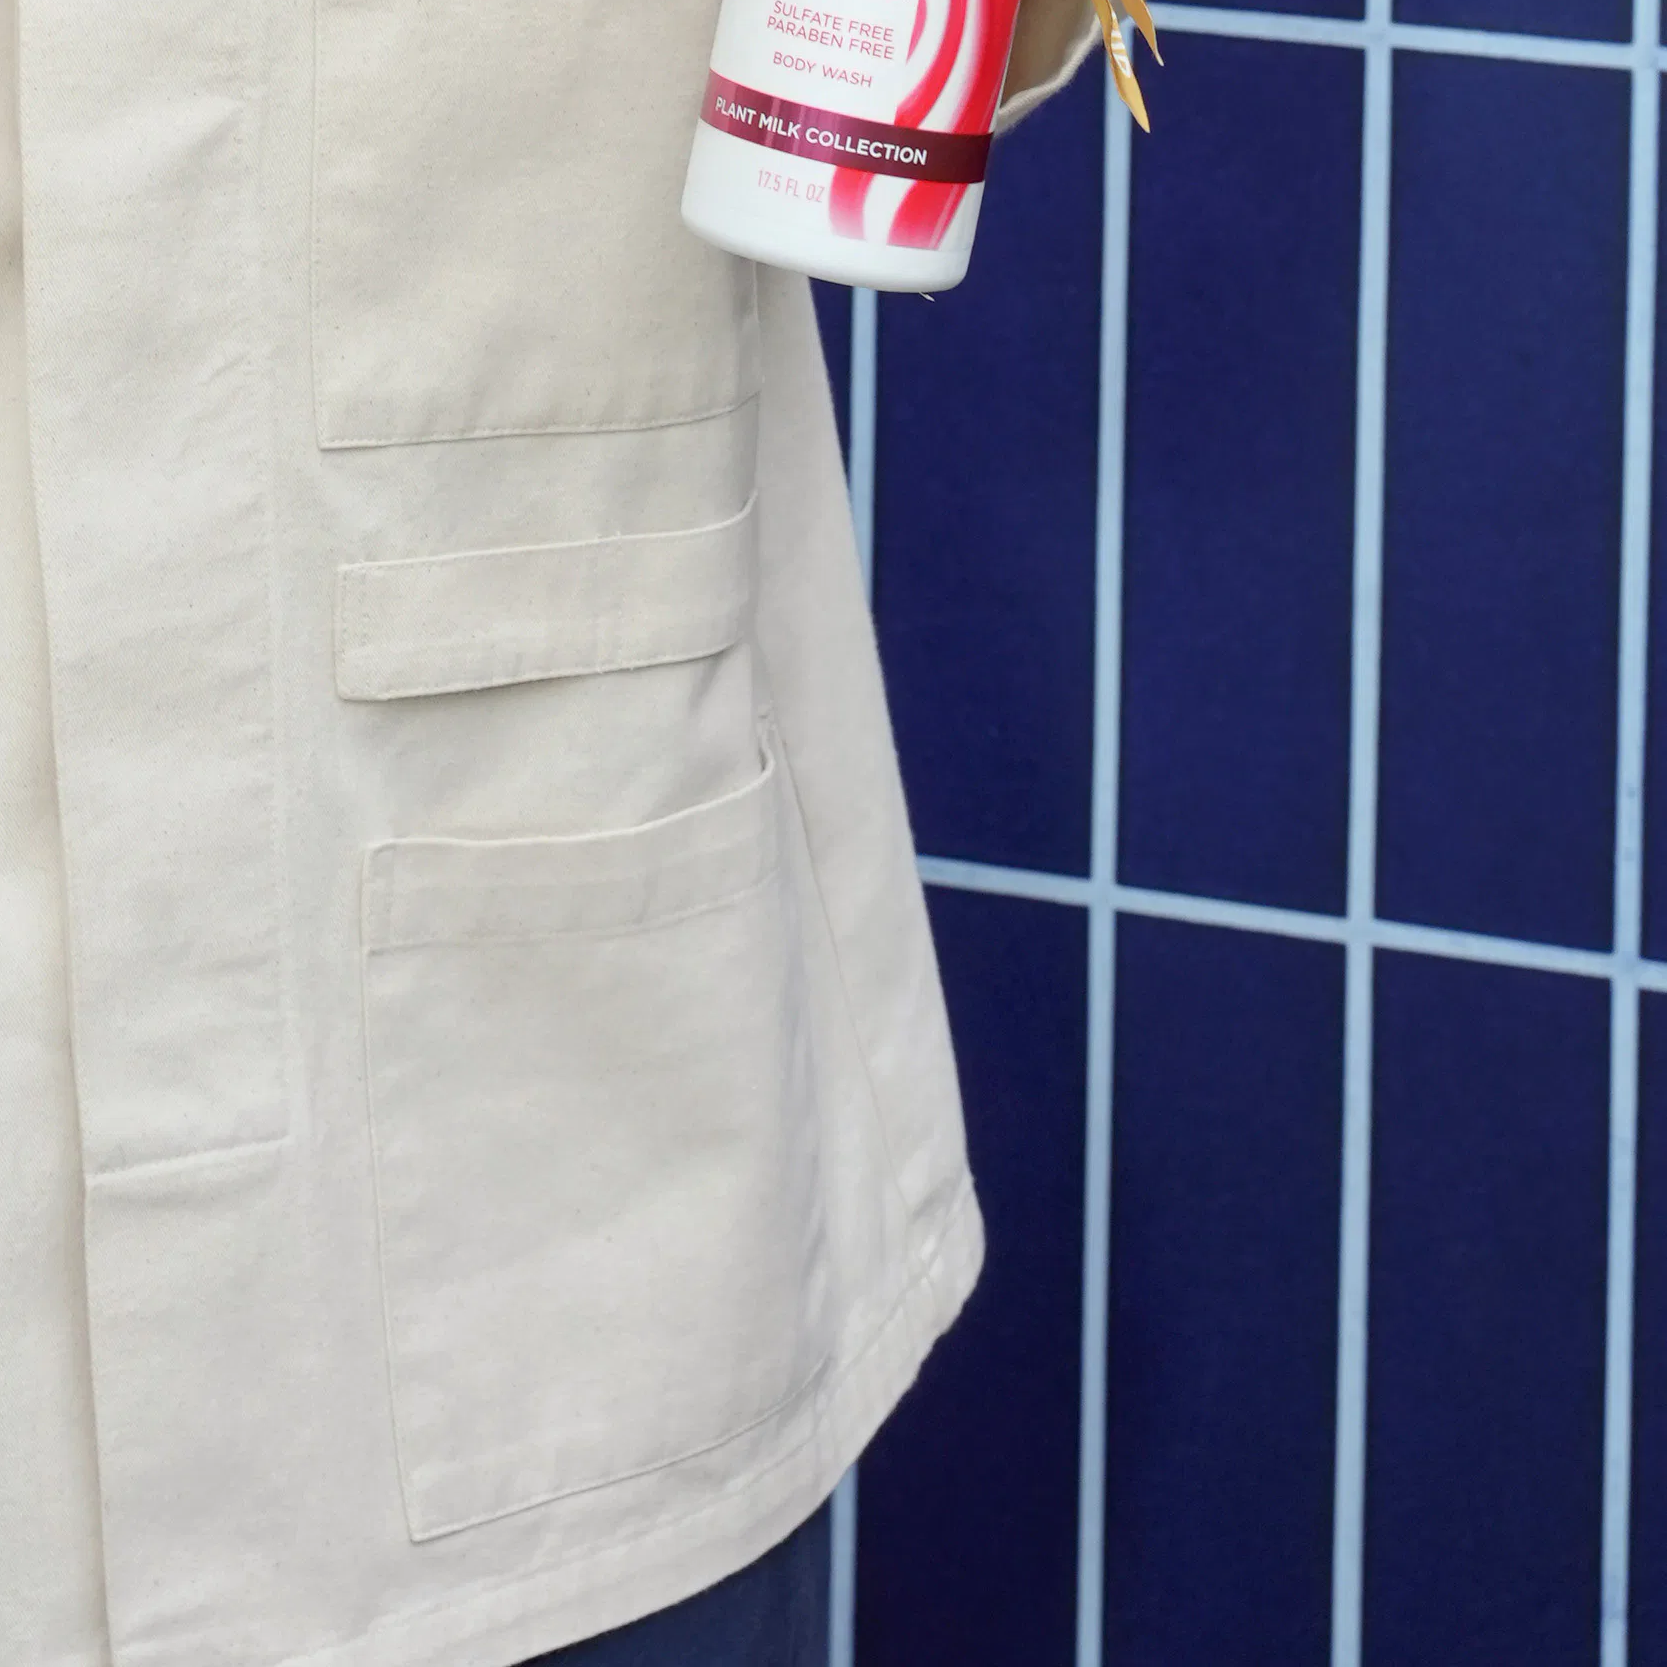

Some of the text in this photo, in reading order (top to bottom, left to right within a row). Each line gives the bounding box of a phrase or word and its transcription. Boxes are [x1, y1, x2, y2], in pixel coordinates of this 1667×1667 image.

[766, 15, 896, 61] PARABEN FREE
[773, 0, 895, 43] SULFATE FREE
[772, 51, 874, 88] BODY WASH
[714, 96, 929, 167] PLANT MILK COLLECTION
[756, 169, 827, 204] 17.5 FL OZ
